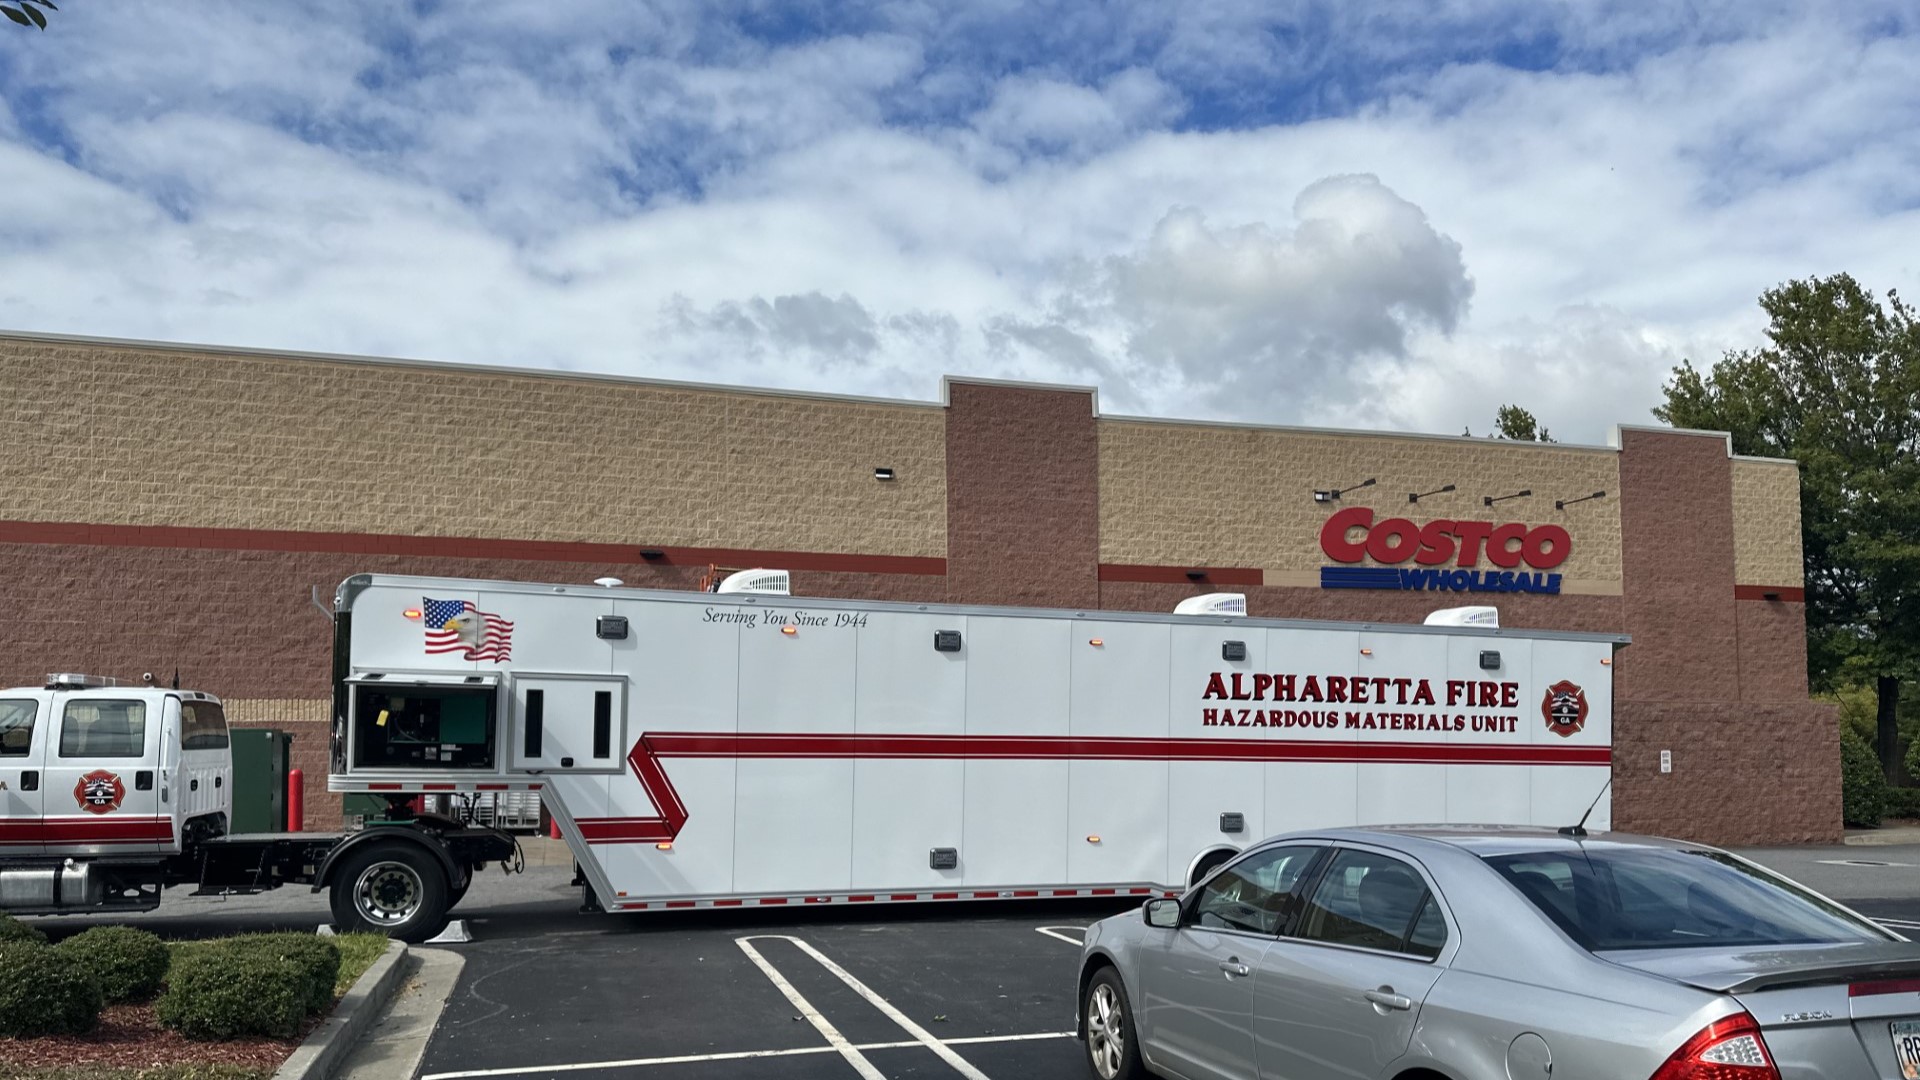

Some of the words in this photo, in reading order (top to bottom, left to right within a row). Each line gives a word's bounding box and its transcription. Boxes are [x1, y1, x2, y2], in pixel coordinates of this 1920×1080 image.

[1320, 507, 1571, 568] COSTCO
[1400, 569, 1562, 594] WHOLESALE
[703, 607, 756, 628] Serving
[763, 609, 787, 625] You
[792, 611, 828, 626] Since
[834, 613, 868, 627] 1944
[1202, 672, 1436, 705] ALPHARETTA
[1446, 680, 1519, 708] FIRE
[1203, 709, 1338, 728] HAZARDOUS
[1345, 712, 1465, 731] MATERIALS
[1471, 715, 1518, 733] UNIT
[1781, 1010, 1832, 1022] FUSION
